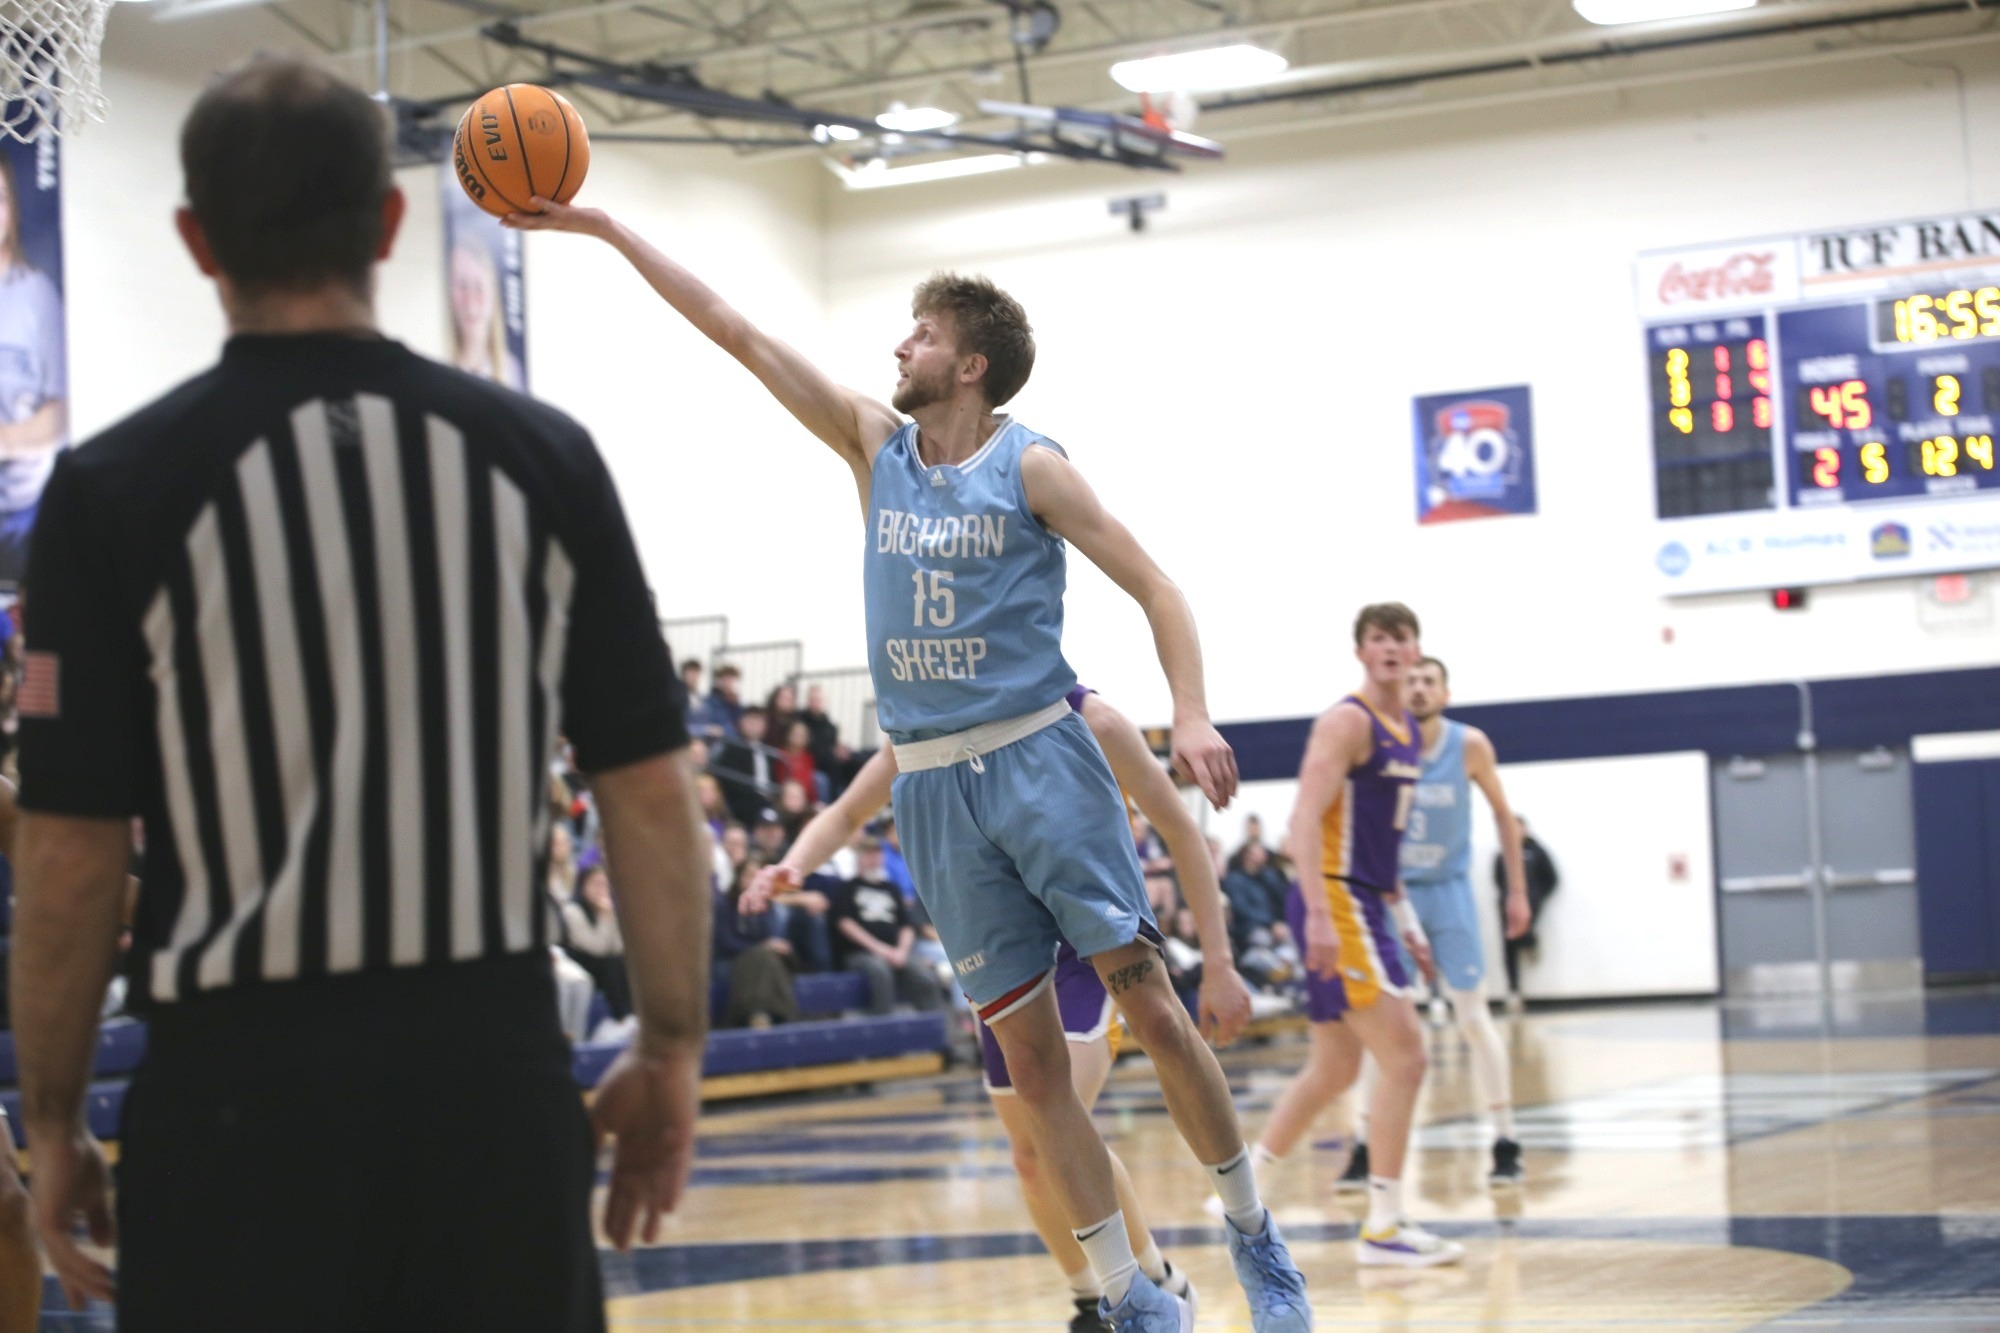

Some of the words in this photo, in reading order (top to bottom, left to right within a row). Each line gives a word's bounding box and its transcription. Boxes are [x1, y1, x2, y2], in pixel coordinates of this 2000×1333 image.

[1894, 286, 2000, 345] 16:55
[1809, 379, 1872, 430] 45
[1933, 374, 1961, 417] 2
[1437, 427, 1508, 480] 40
[1812, 446, 1841, 489] 2
[877, 508, 1006, 559] BIGHORN
[911, 568, 956, 628] 15
[886, 637, 987, 682] SHEEP
[956, 951, 985, 976] NCU
